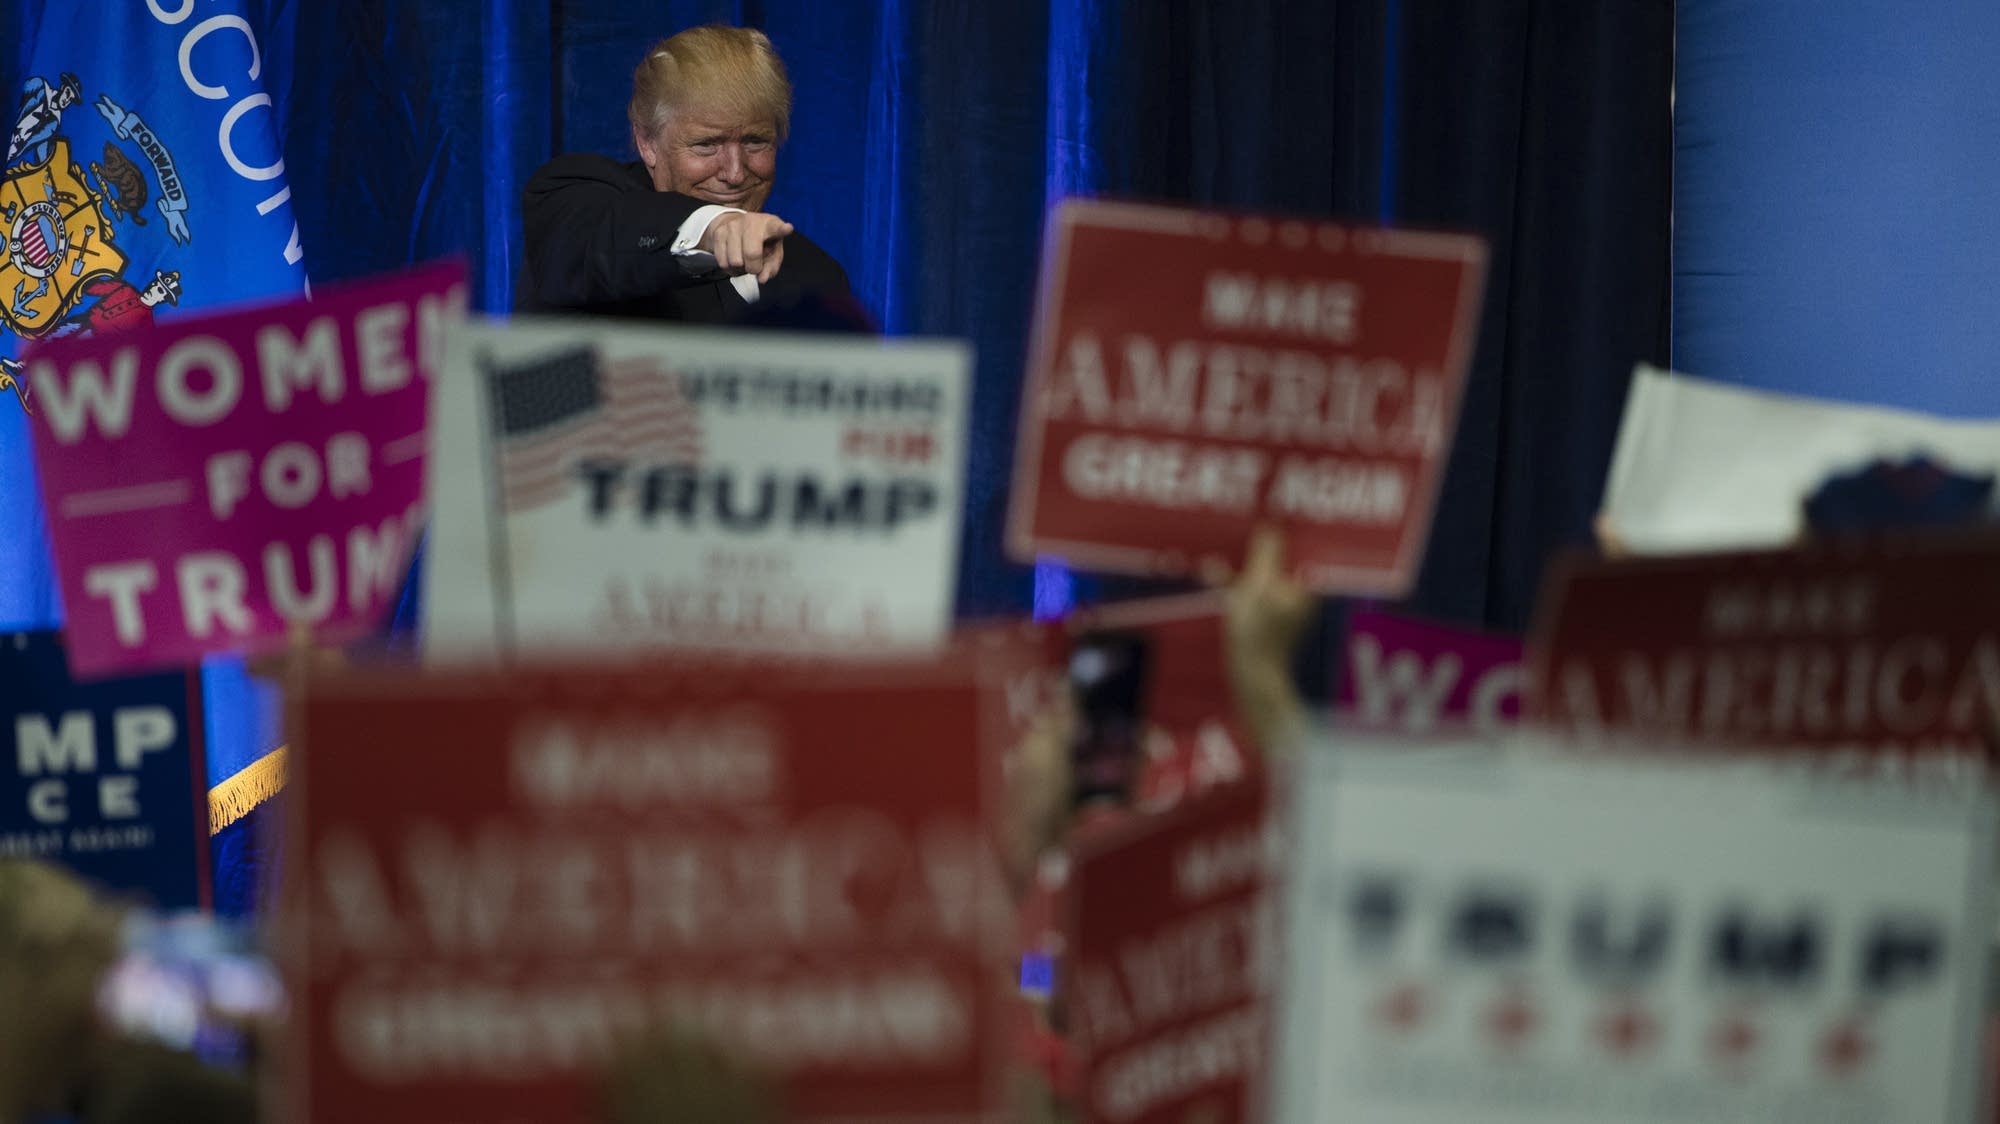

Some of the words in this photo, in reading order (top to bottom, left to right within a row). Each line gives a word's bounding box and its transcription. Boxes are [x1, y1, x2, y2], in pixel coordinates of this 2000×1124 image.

[130, 122, 183, 203] FORWARD
[31, 204, 65, 240] PLURIBUS
[43, 248, 64, 276] UNUM
[1207, 274, 1359, 342] MAKE
[682, 364, 942, 416] VETERANS
[1037, 332, 1446, 460] AMERICA
[206, 431, 371, 520] FOR
[841, 426, 940, 464] FOR
[1063, 432, 1264, 513] GREAT
[580, 458, 938, 534] TRUMP
[1345, 872, 1948, 1000] TRUMP
